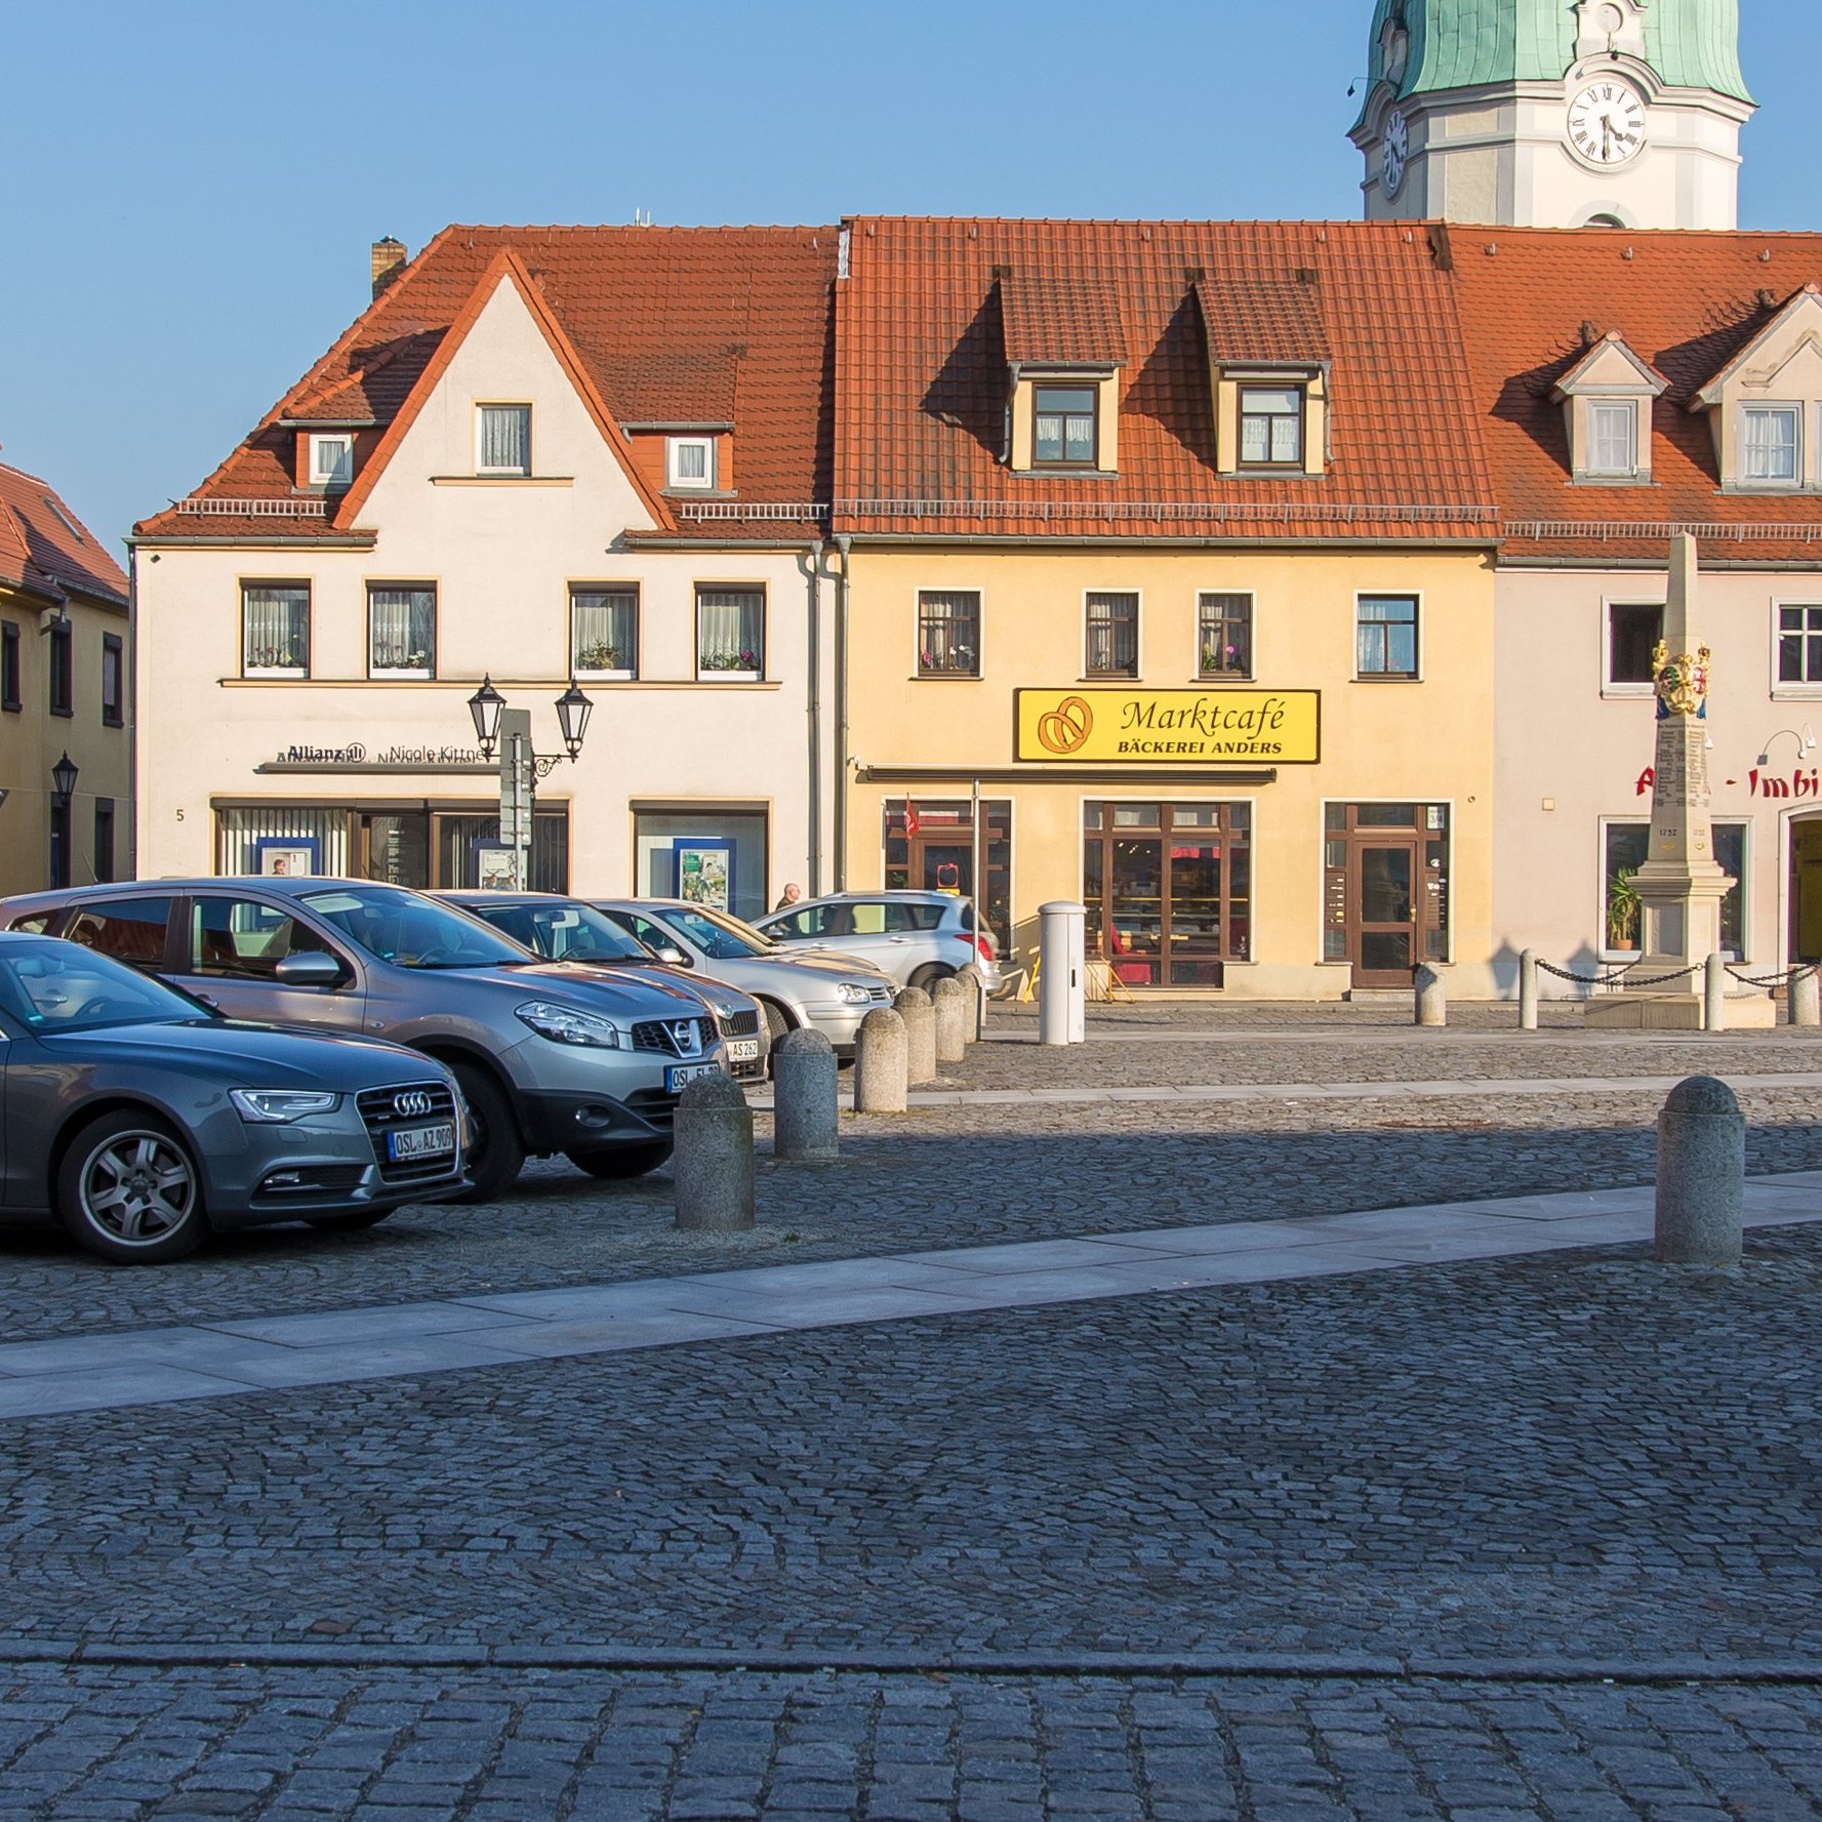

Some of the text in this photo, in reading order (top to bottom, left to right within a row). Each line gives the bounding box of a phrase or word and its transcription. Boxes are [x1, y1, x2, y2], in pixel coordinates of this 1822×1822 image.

[1120, 697, 1286, 740] Marktcafé
[288, 745, 488, 761] Allianz Nicole Kittne
[1117, 738, 1282, 754] BÄCKEREI ANDERS
[176, 808, 184, 822] 5
[733, 1043, 743, 1056] AS
[396, 1133, 417, 1154] OSL
[423, 1129, 436, 1151] AZ
